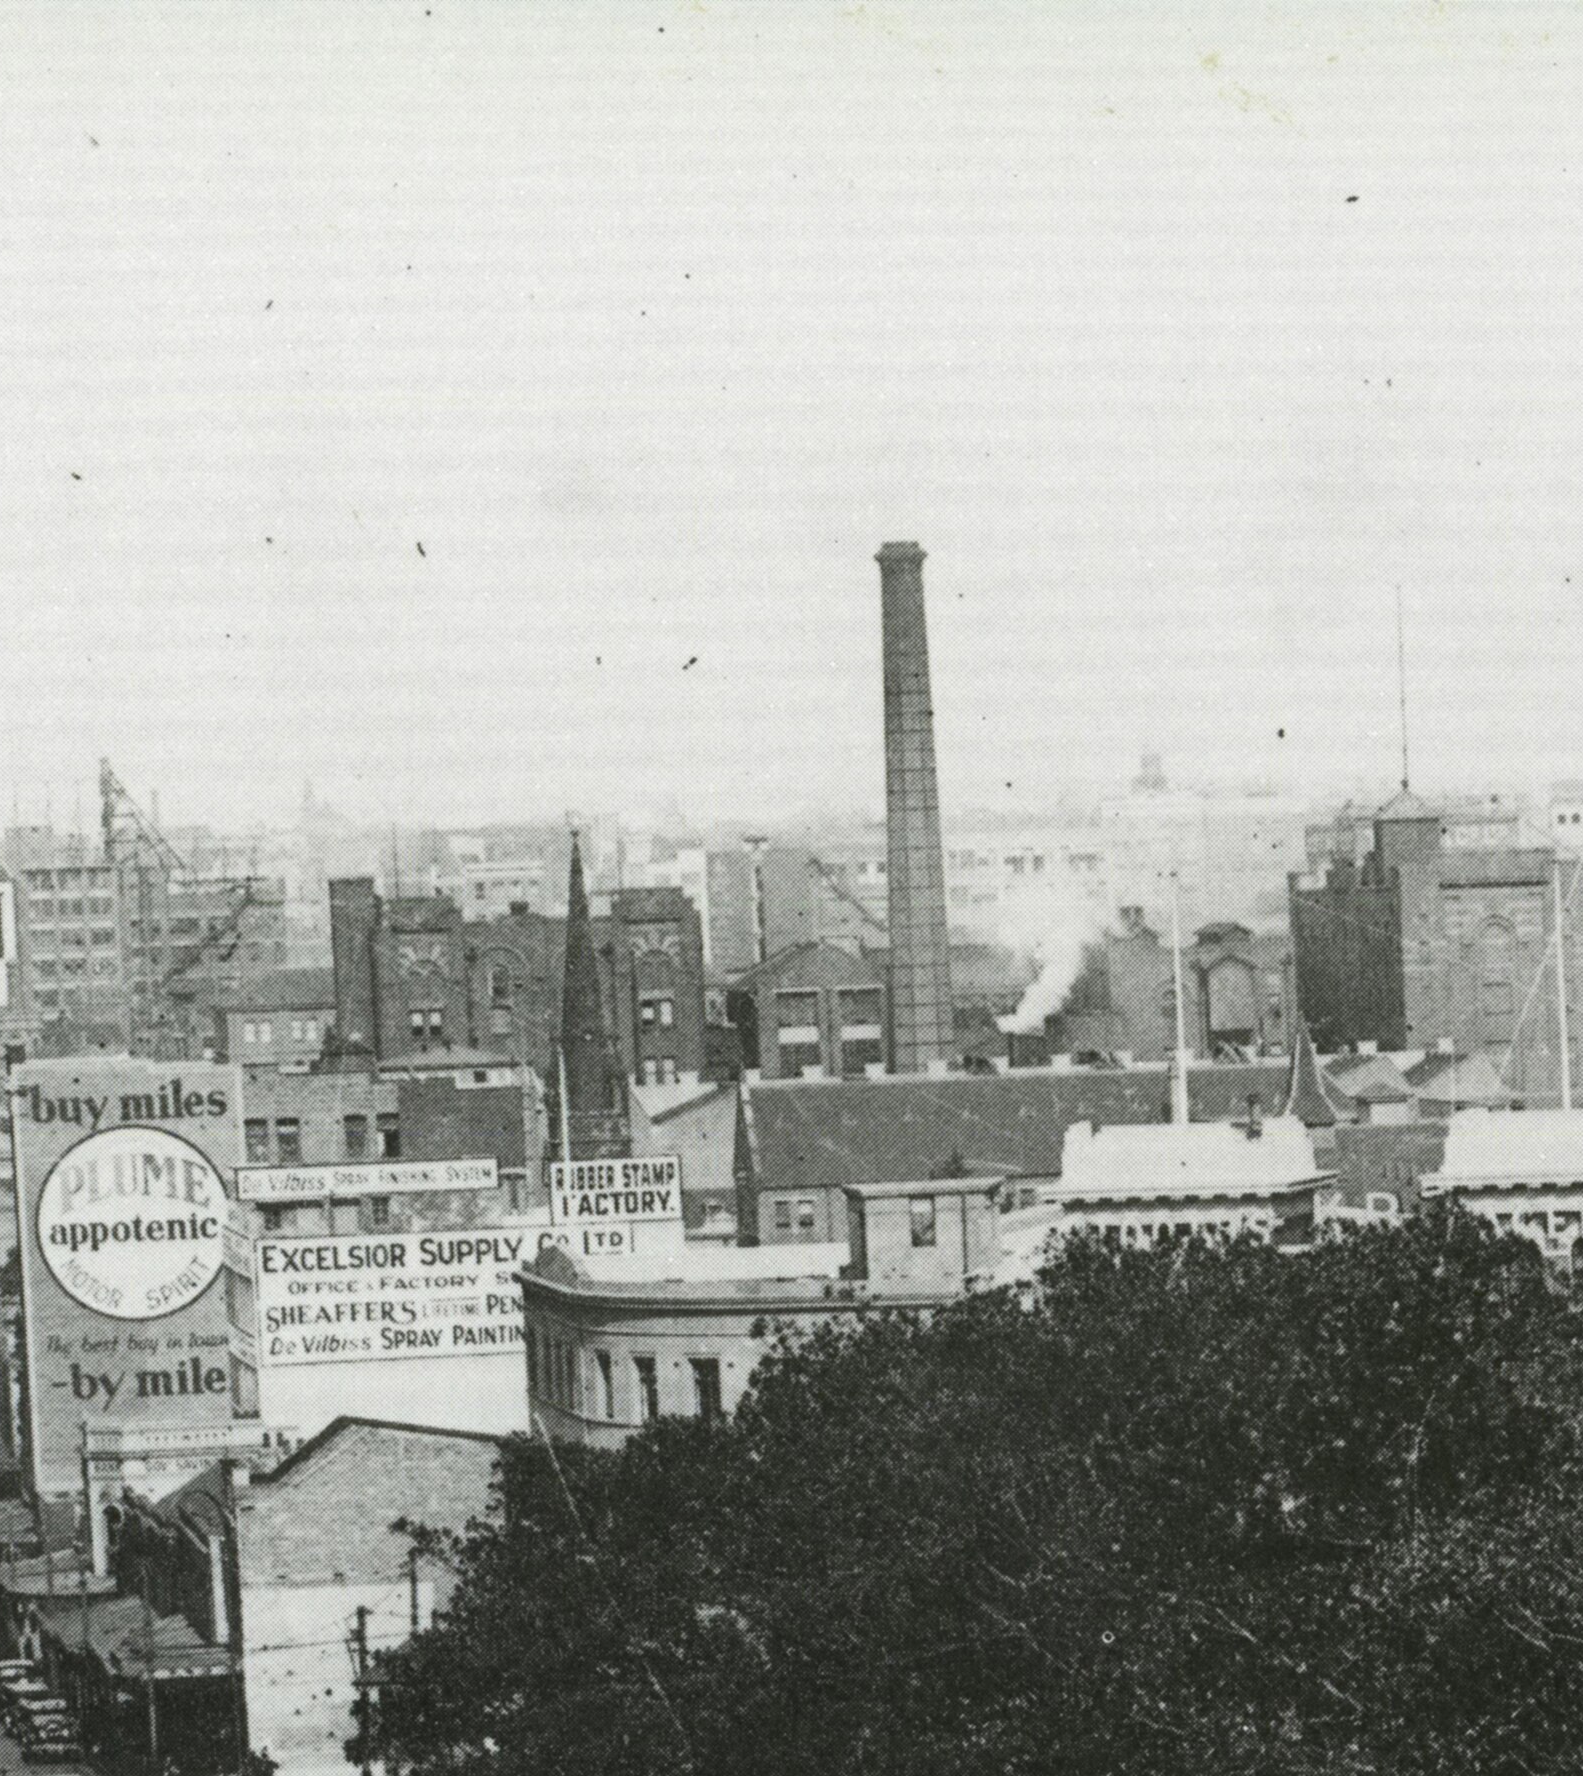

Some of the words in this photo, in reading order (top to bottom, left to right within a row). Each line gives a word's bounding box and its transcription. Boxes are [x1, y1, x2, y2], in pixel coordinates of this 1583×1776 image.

[30, 1083, 108, 1131] buy
[120, 1079, 228, 1122] miles
[59, 1153, 211, 1215] PLUME
[621, 1160, 675, 1189] STAMP
[49, 1211, 218, 1252] appotenic
[262, 1238, 408, 1276] EXCELSIOR
[420, 1234, 522, 1268] SUPPLY
[144, 1255, 210, 1310] SPIRIT
[287, 1278, 361, 1297] OFFICE
[379, 1272, 480, 1293] FACTORY
[268, 1336, 298, 1358] De
[379, 1326, 444, 1351] SPRAY
[136, 1356, 227, 1398] mile
